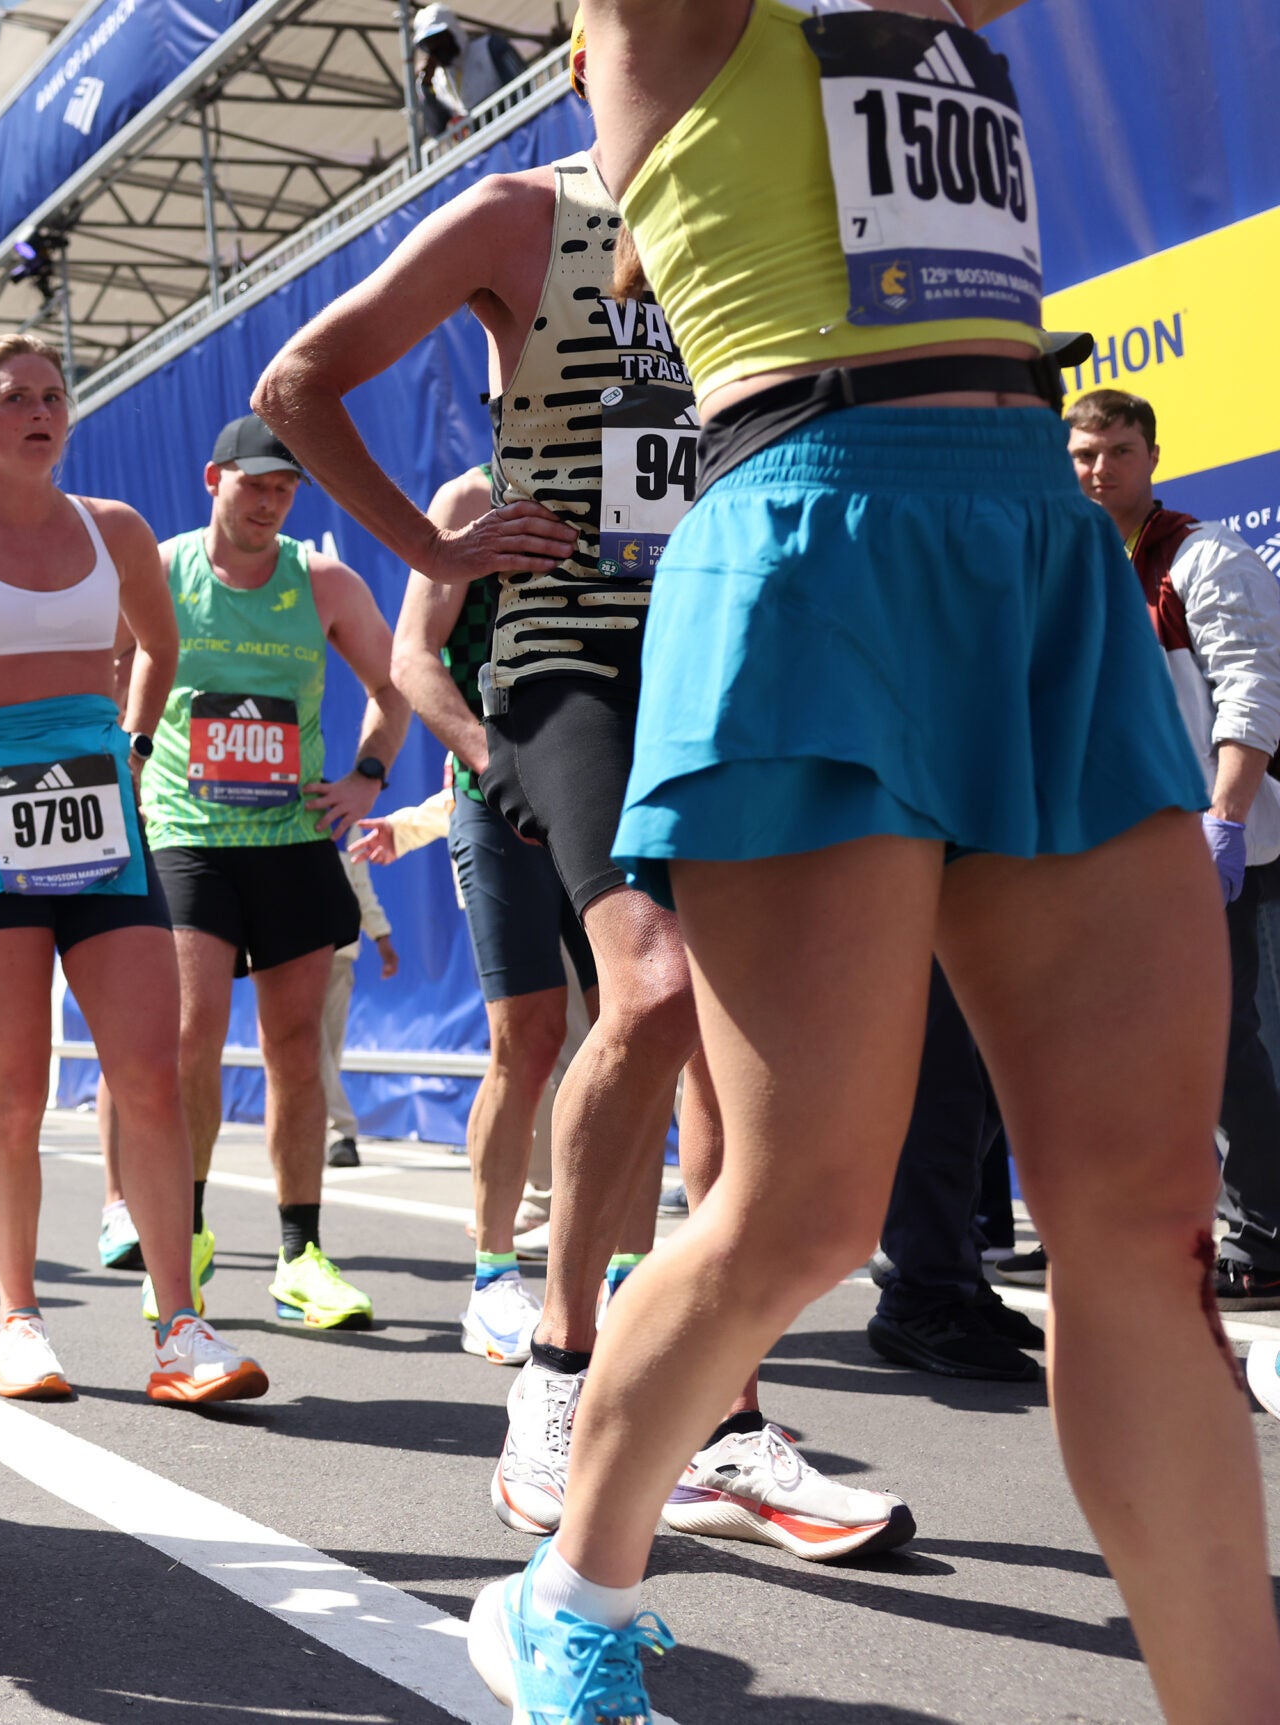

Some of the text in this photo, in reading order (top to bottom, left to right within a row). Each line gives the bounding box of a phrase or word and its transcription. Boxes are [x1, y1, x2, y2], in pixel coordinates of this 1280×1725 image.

[853, 89, 1027, 223] 15005
[852, 217, 867, 239] 7
[600, 298, 673, 352] VA
[636, 433, 698, 501] 94
[613, 510, 621, 524] 1
[1245, 507, 1271, 529] OF
[180, 637, 231, 652] LECTRIC
[235, 641, 290, 658] ATHLETIC
[206, 722, 284, 765] 3406
[12, 794, 104, 848] 9790
[2, 856, 10, 864] 2
